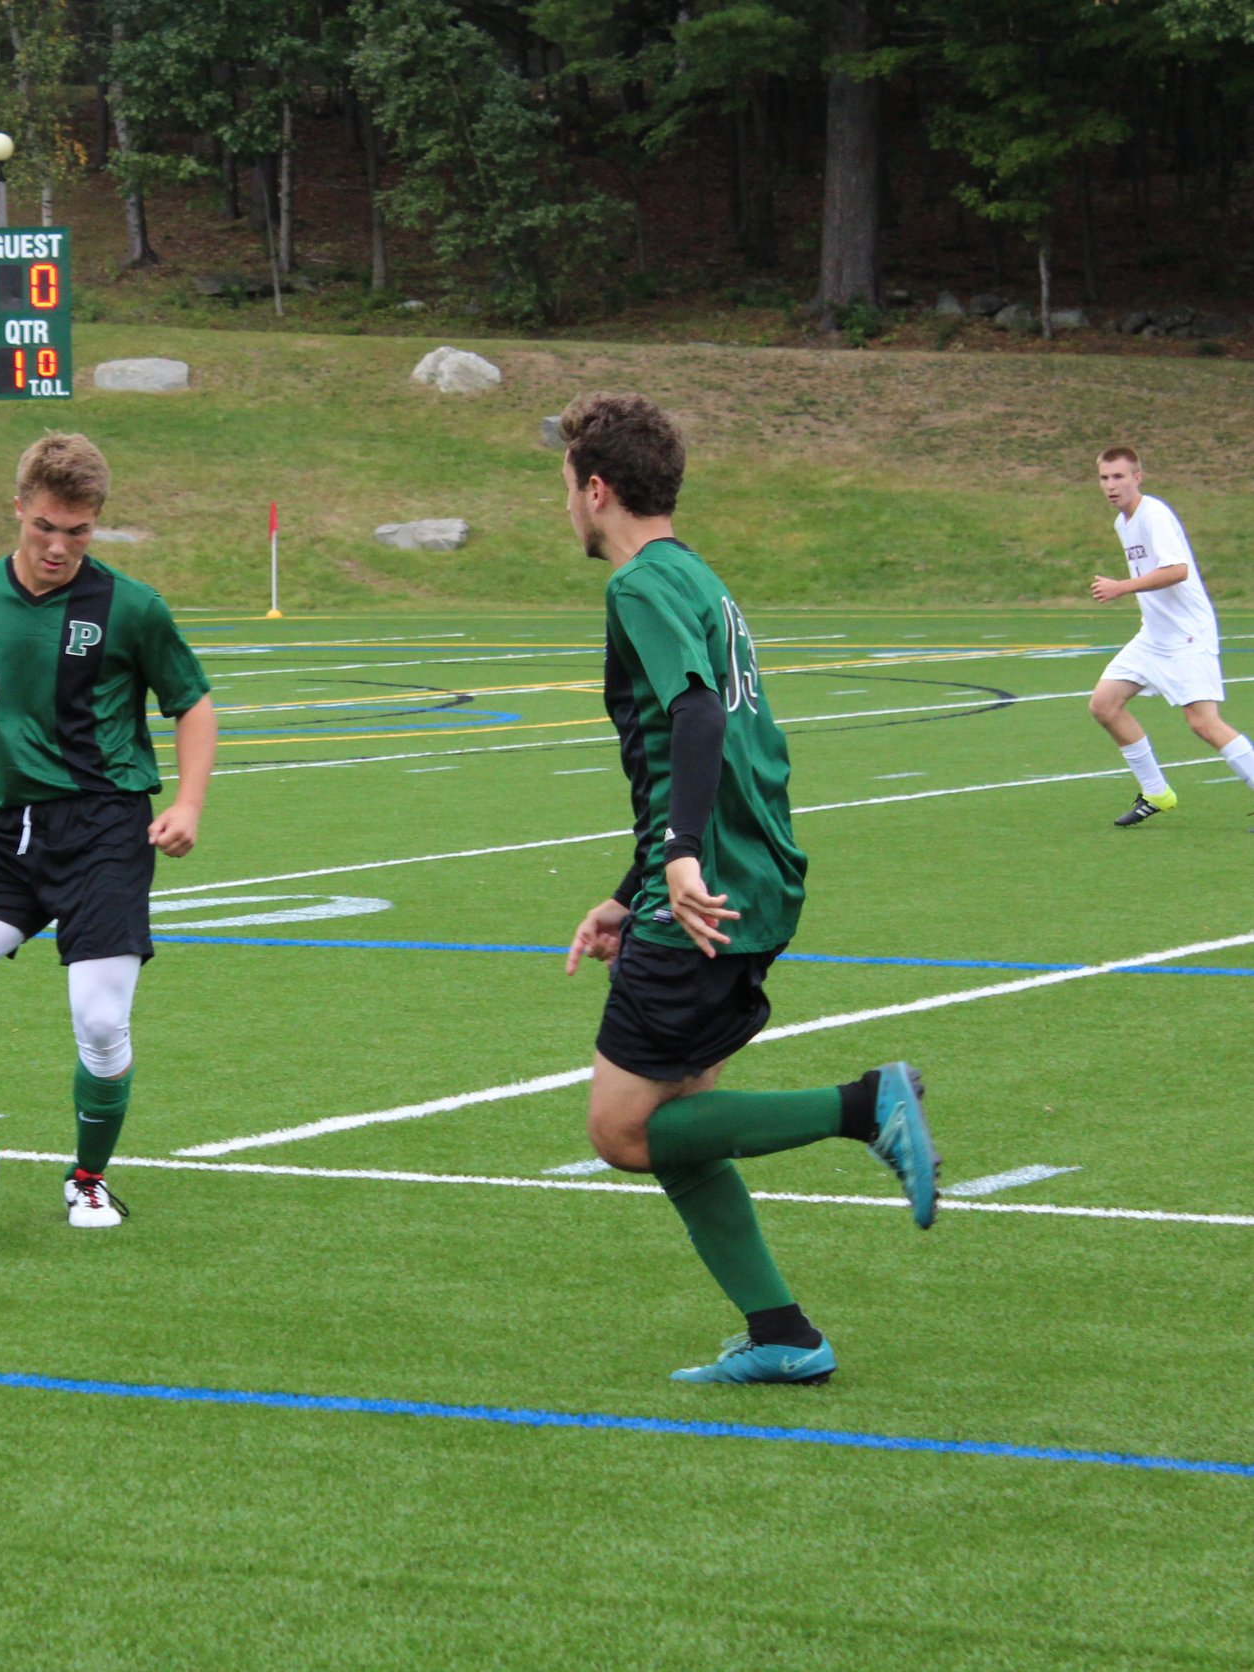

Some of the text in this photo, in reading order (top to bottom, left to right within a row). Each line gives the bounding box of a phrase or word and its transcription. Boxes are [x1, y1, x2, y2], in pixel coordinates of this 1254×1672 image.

[29, 262, 59, 309] 0
[5, 319, 49, 345] QTR
[28, 379, 70, 396] T.O.L.
[64, 620, 102, 656] P
